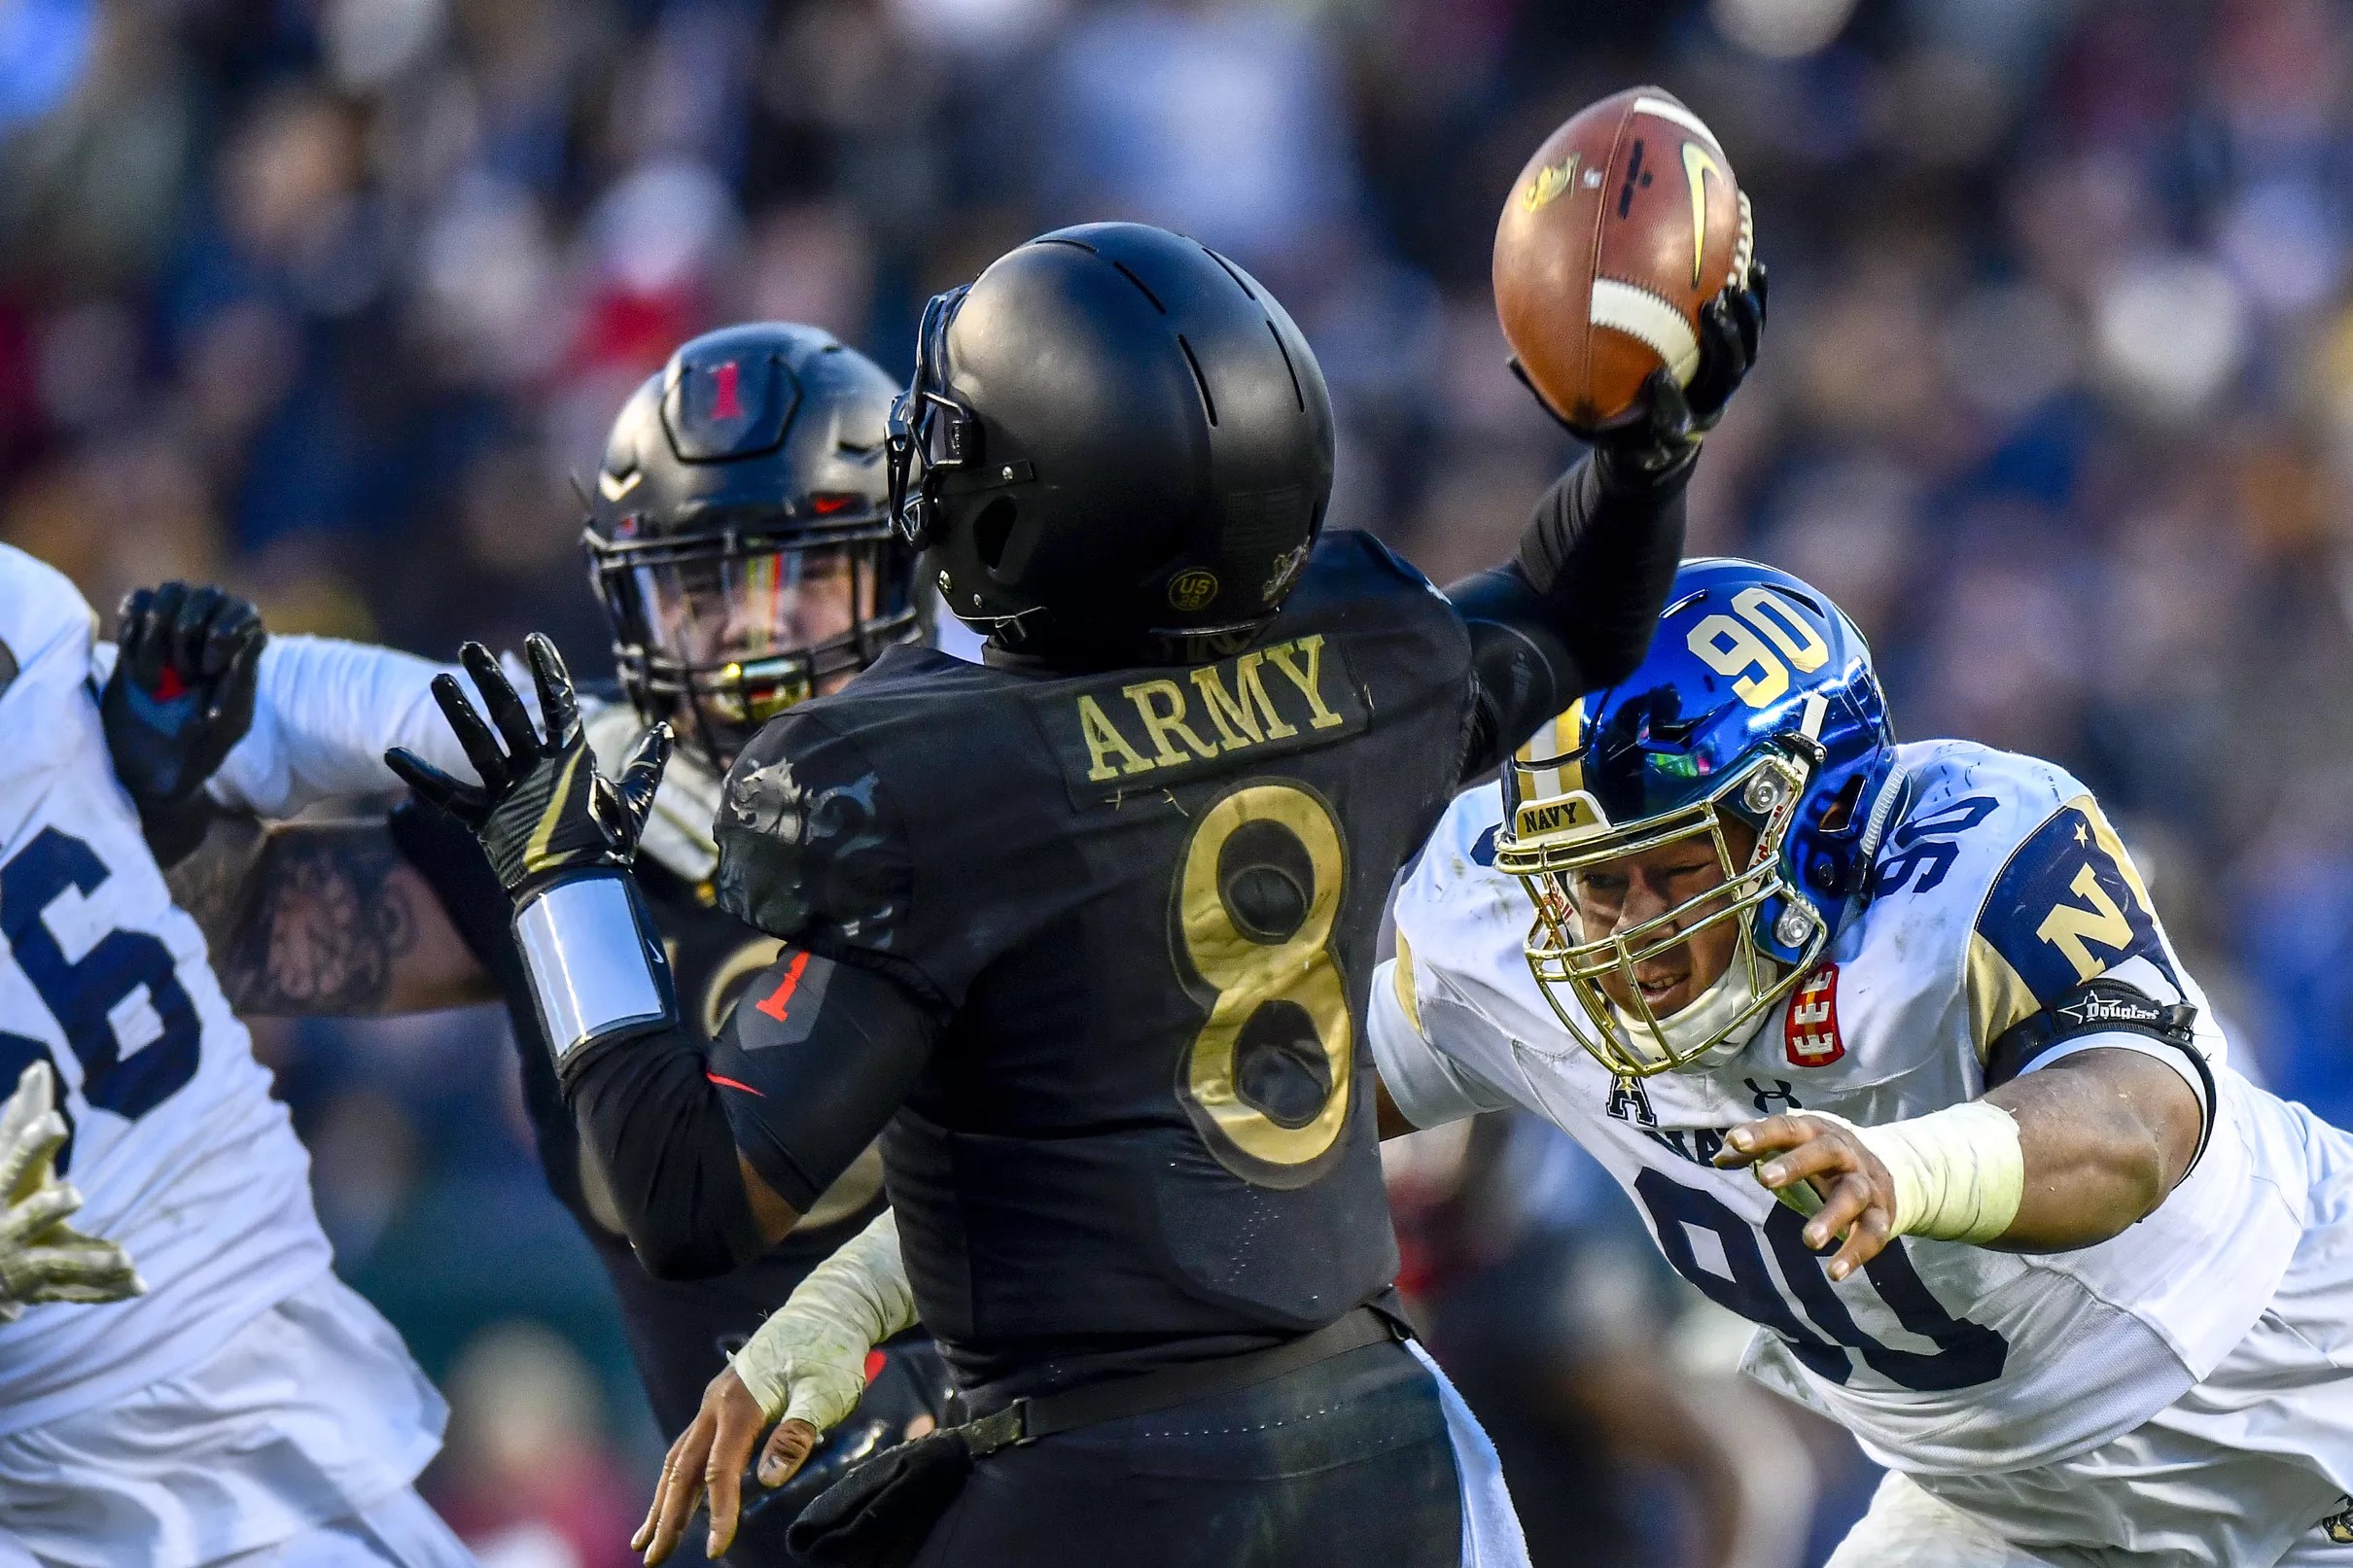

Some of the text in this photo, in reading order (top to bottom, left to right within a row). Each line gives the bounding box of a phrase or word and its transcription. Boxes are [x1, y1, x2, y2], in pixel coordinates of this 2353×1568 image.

[712, 362, 743, 419] 1
[1179, 577, 1212, 595] US
[1687, 587, 1829, 709] 90
[1076, 634, 1343, 782] ARMY
[1523, 802, 1578, 833] NAVY
[1874, 796, 2000, 900] 90
[1182, 784, 1352, 1165] 8
[2036, 861, 2134, 986] N
[755, 950, 810, 1023] 1
[1642, 1128, 1731, 1167] NA
[1633, 1166, 2009, 1391] 90
